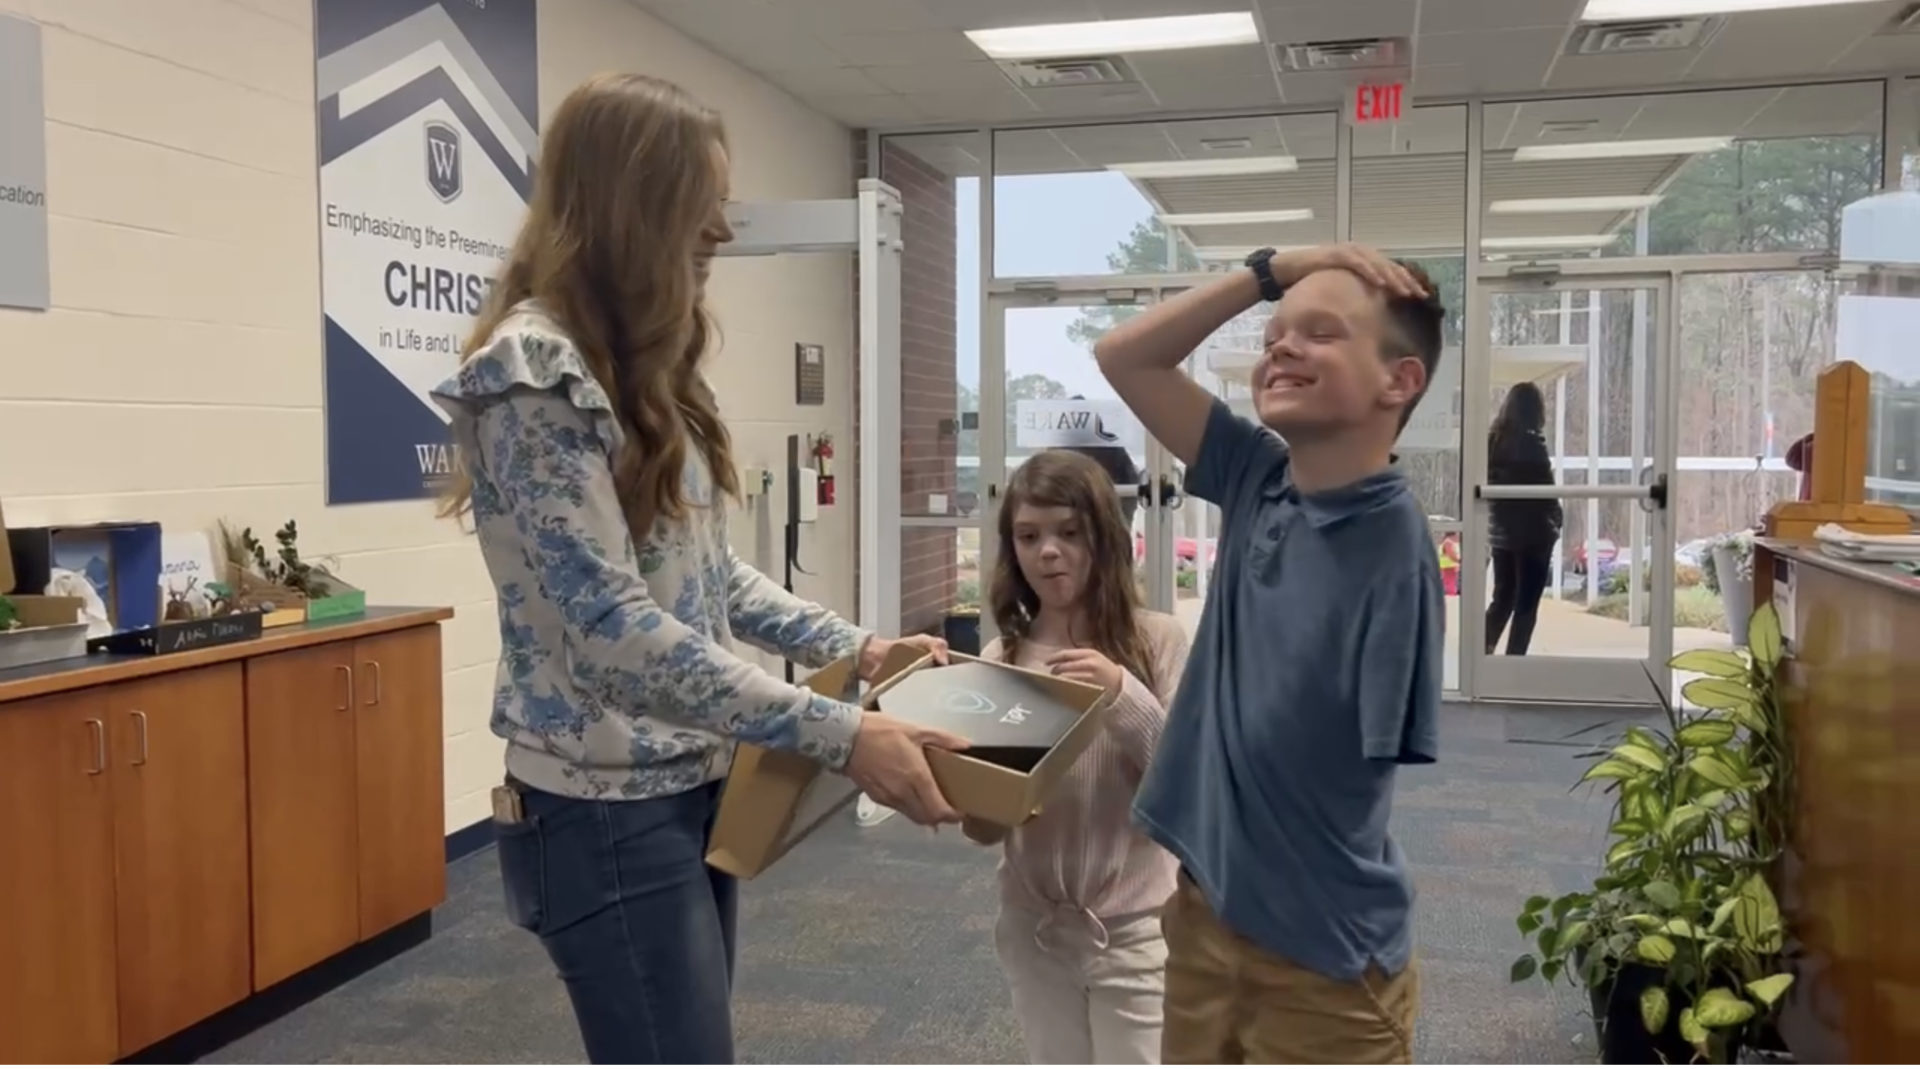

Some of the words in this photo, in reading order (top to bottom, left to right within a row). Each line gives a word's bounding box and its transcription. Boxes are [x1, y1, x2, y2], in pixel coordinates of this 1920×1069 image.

[1356, 83, 1403, 123] EXIT
[429, 137, 456, 181] W
[326, 203, 422, 249] Emphasizing
[425, 226, 446, 248] the
[450, 230, 511, 261] Preemine
[379, 326, 392, 347] in
[396, 329, 421, 351] Life
[425, 333, 449, 353] and
